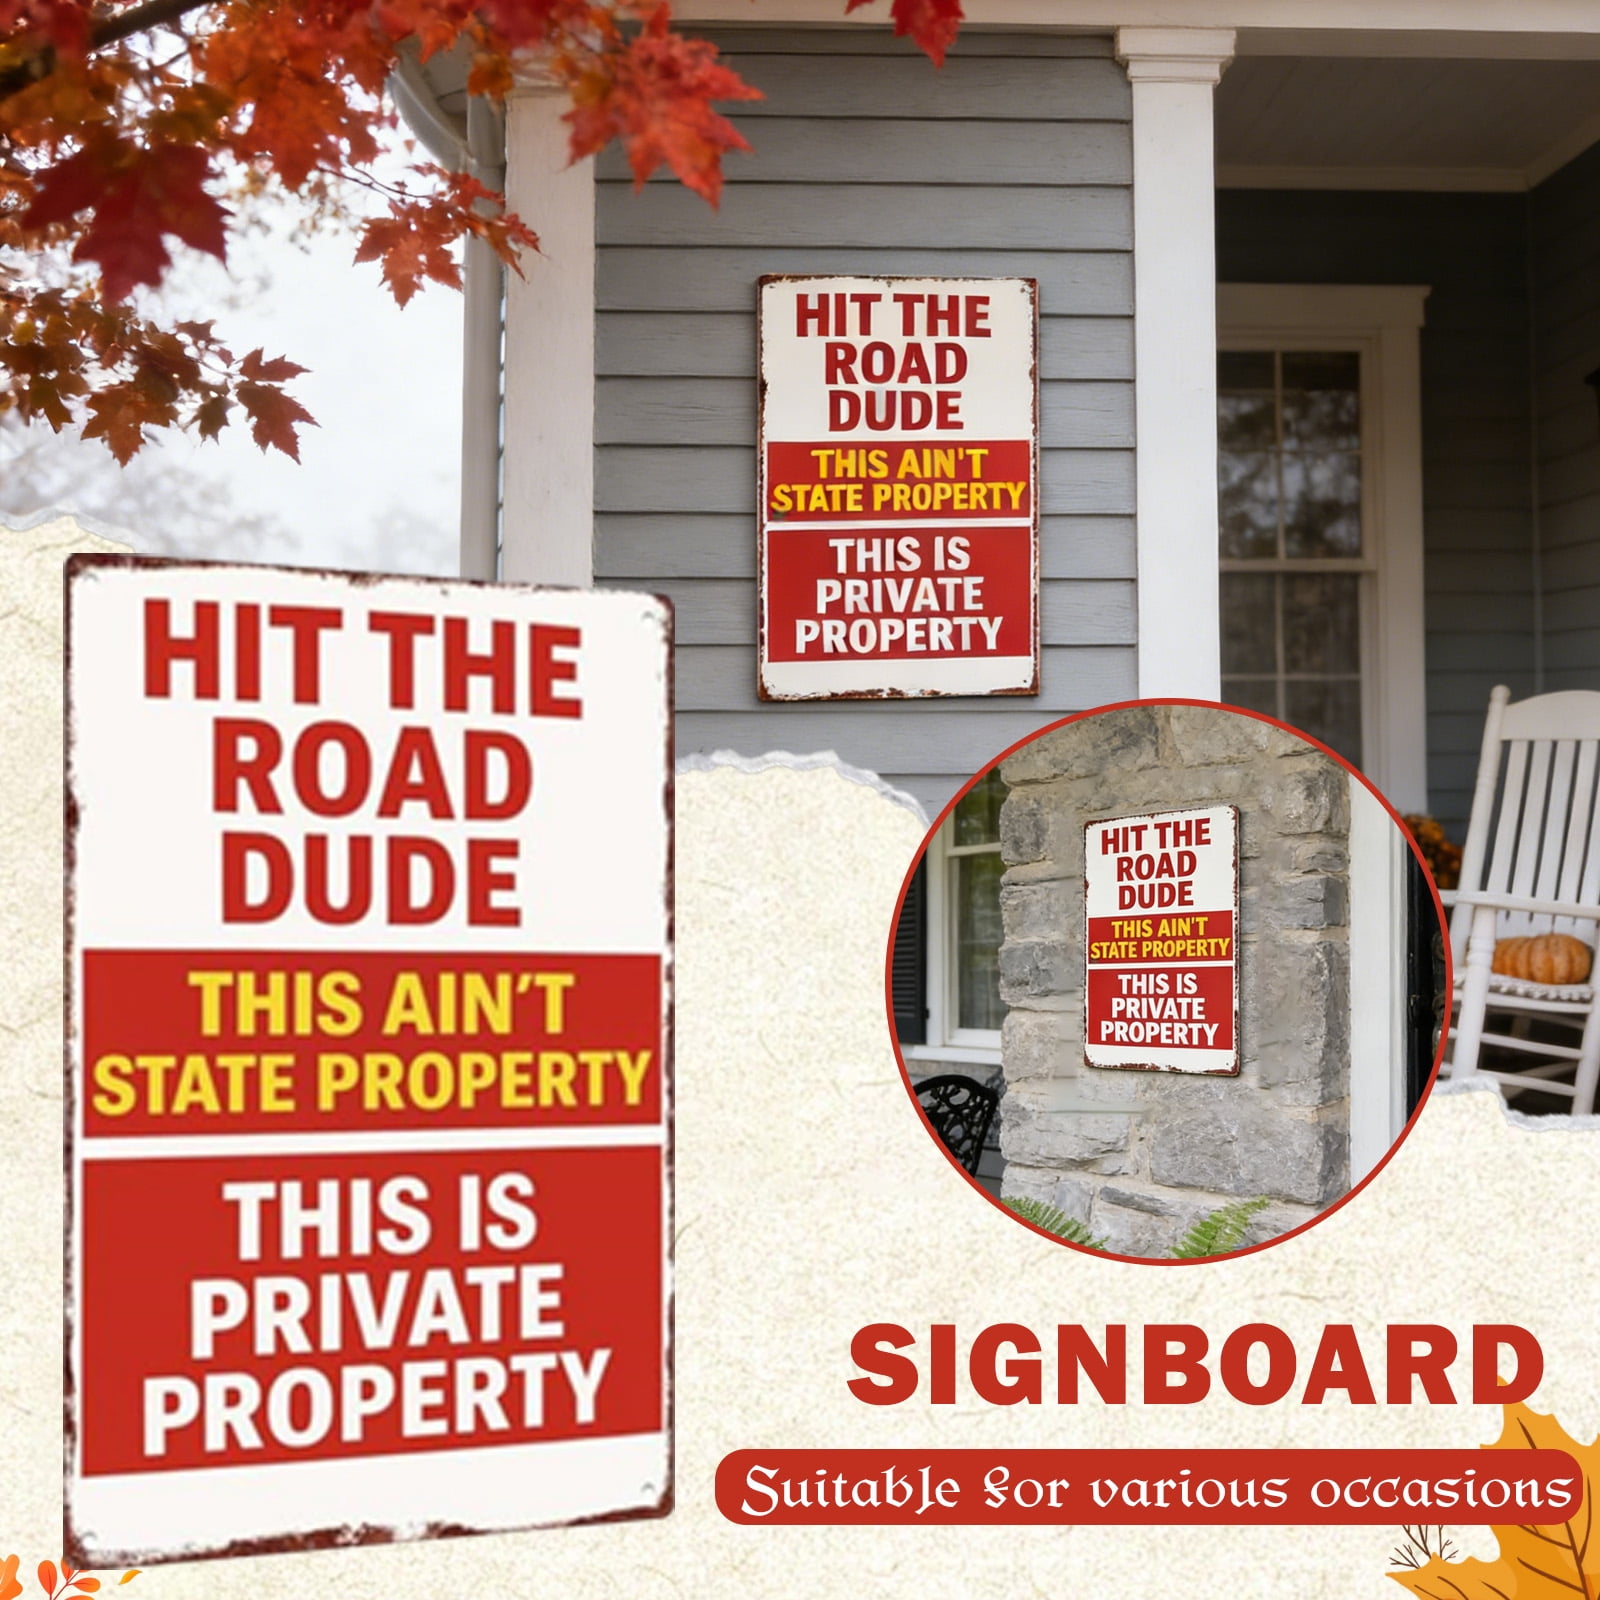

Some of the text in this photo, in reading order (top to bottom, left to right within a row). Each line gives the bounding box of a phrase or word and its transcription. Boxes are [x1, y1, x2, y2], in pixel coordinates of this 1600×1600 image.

[796, 293, 991, 338] HIT THE
[824, 342, 968, 385] ROAD
[828, 390, 964, 432] DUDE
[810, 448, 989, 478] THIS AIN'T
[770, 481, 1027, 513] STATE PROPERTY
[829, 536, 970, 573] THIS IS
[816, 576, 984, 615] PRIVATE
[795, 616, 1003, 654] PROPERTY
[143, 598, 584, 720] HIT THE
[211, 718, 534, 820] ROAD
[1101, 818, 1212, 855] HIT THE
[222, 831, 523, 927] DUDE
[1116, 850, 1197, 882] ROAD
[1118, 881, 1194, 910] DUDE
[1111, 916, 1208, 939] THIS AIN'T
[1090, 938, 1231, 959] STATE PROPERTY
[1118, 973, 1198, 995] THIS IS
[188, 972, 363, 1037] THIS
[1111, 998, 1205, 1020] PRIVATE
[1100, 1021, 1219, 1046] PROPERTY
[92, 1049, 652, 1116] STATE PROPERTY
[223, 1173, 536, 1262] THIS IS
[189, 1265, 565, 1360] PRIVATE
[142, 1348, 612, 1457] PROPERTY
